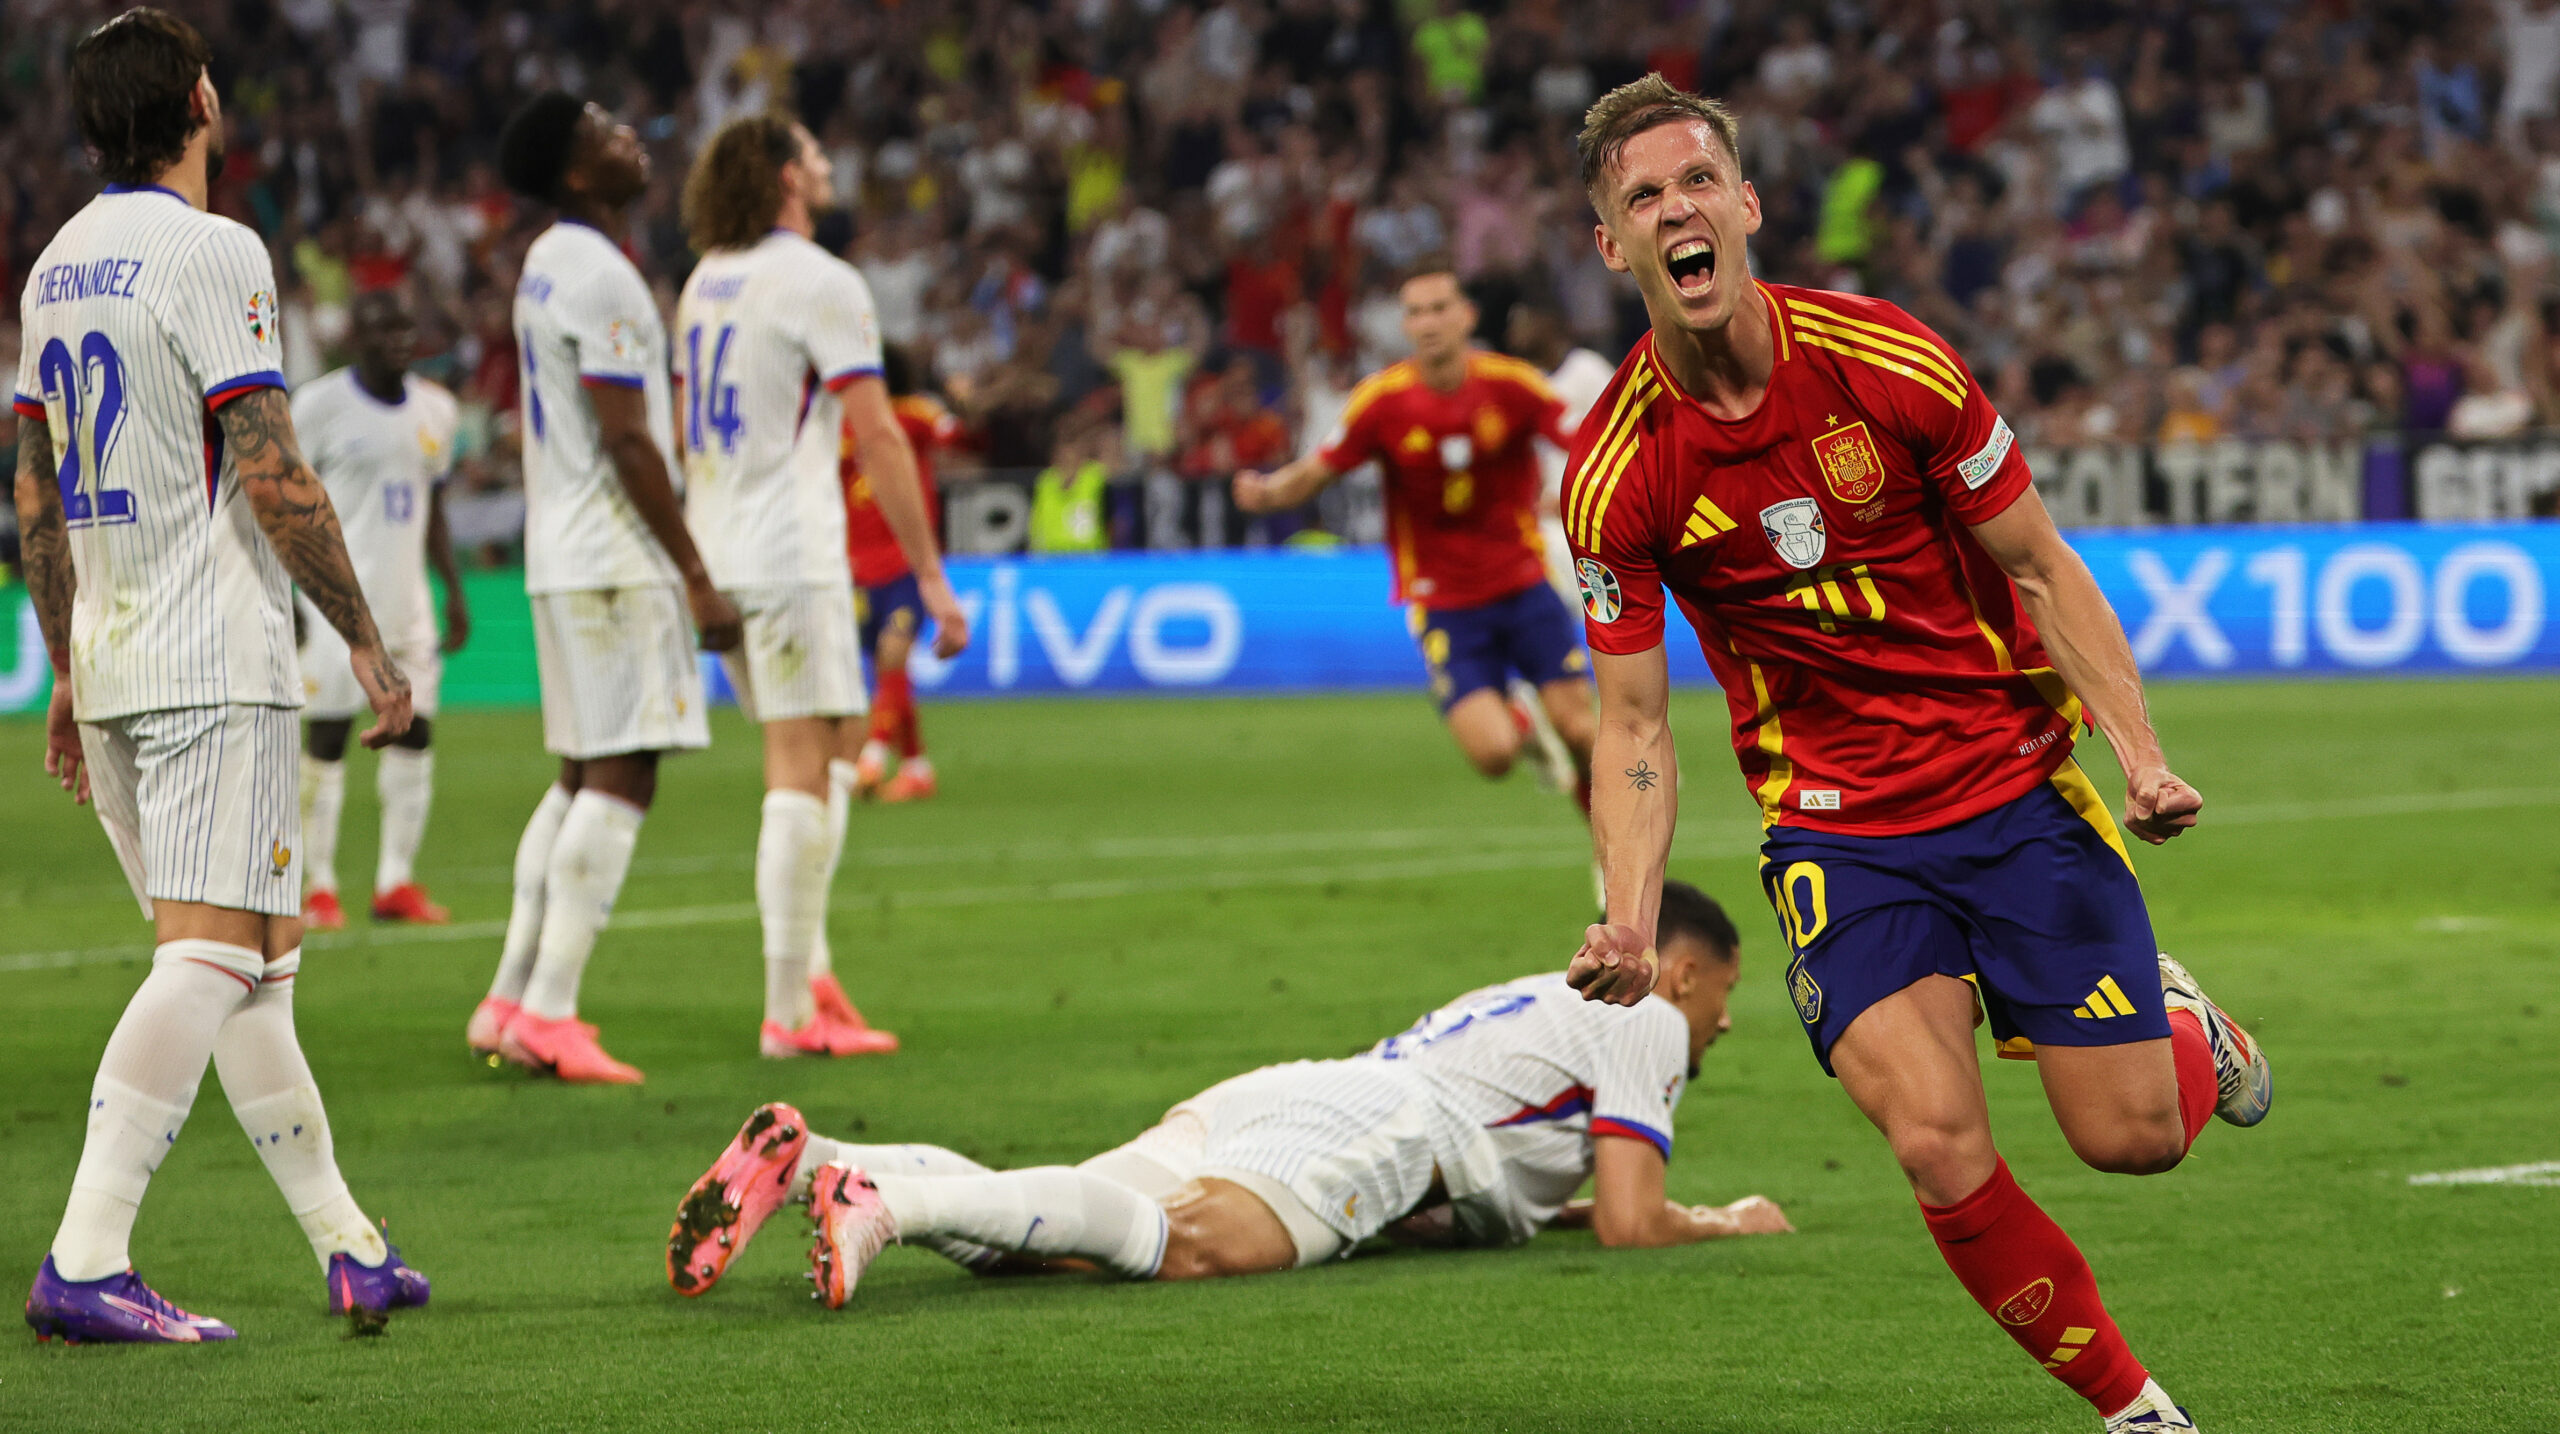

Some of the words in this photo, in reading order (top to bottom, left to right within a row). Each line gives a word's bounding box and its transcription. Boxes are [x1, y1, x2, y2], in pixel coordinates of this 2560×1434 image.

[39, 331, 137, 530] 22
[688, 323, 746, 456] 14
[1960, 458, 1979, 472] UEFA
[1963, 424, 2008, 481] FOUNDATION
[1784, 561, 1886, 634] 10
[2122, 543, 2548, 668] X100
[1772, 861, 1828, 956] 10
